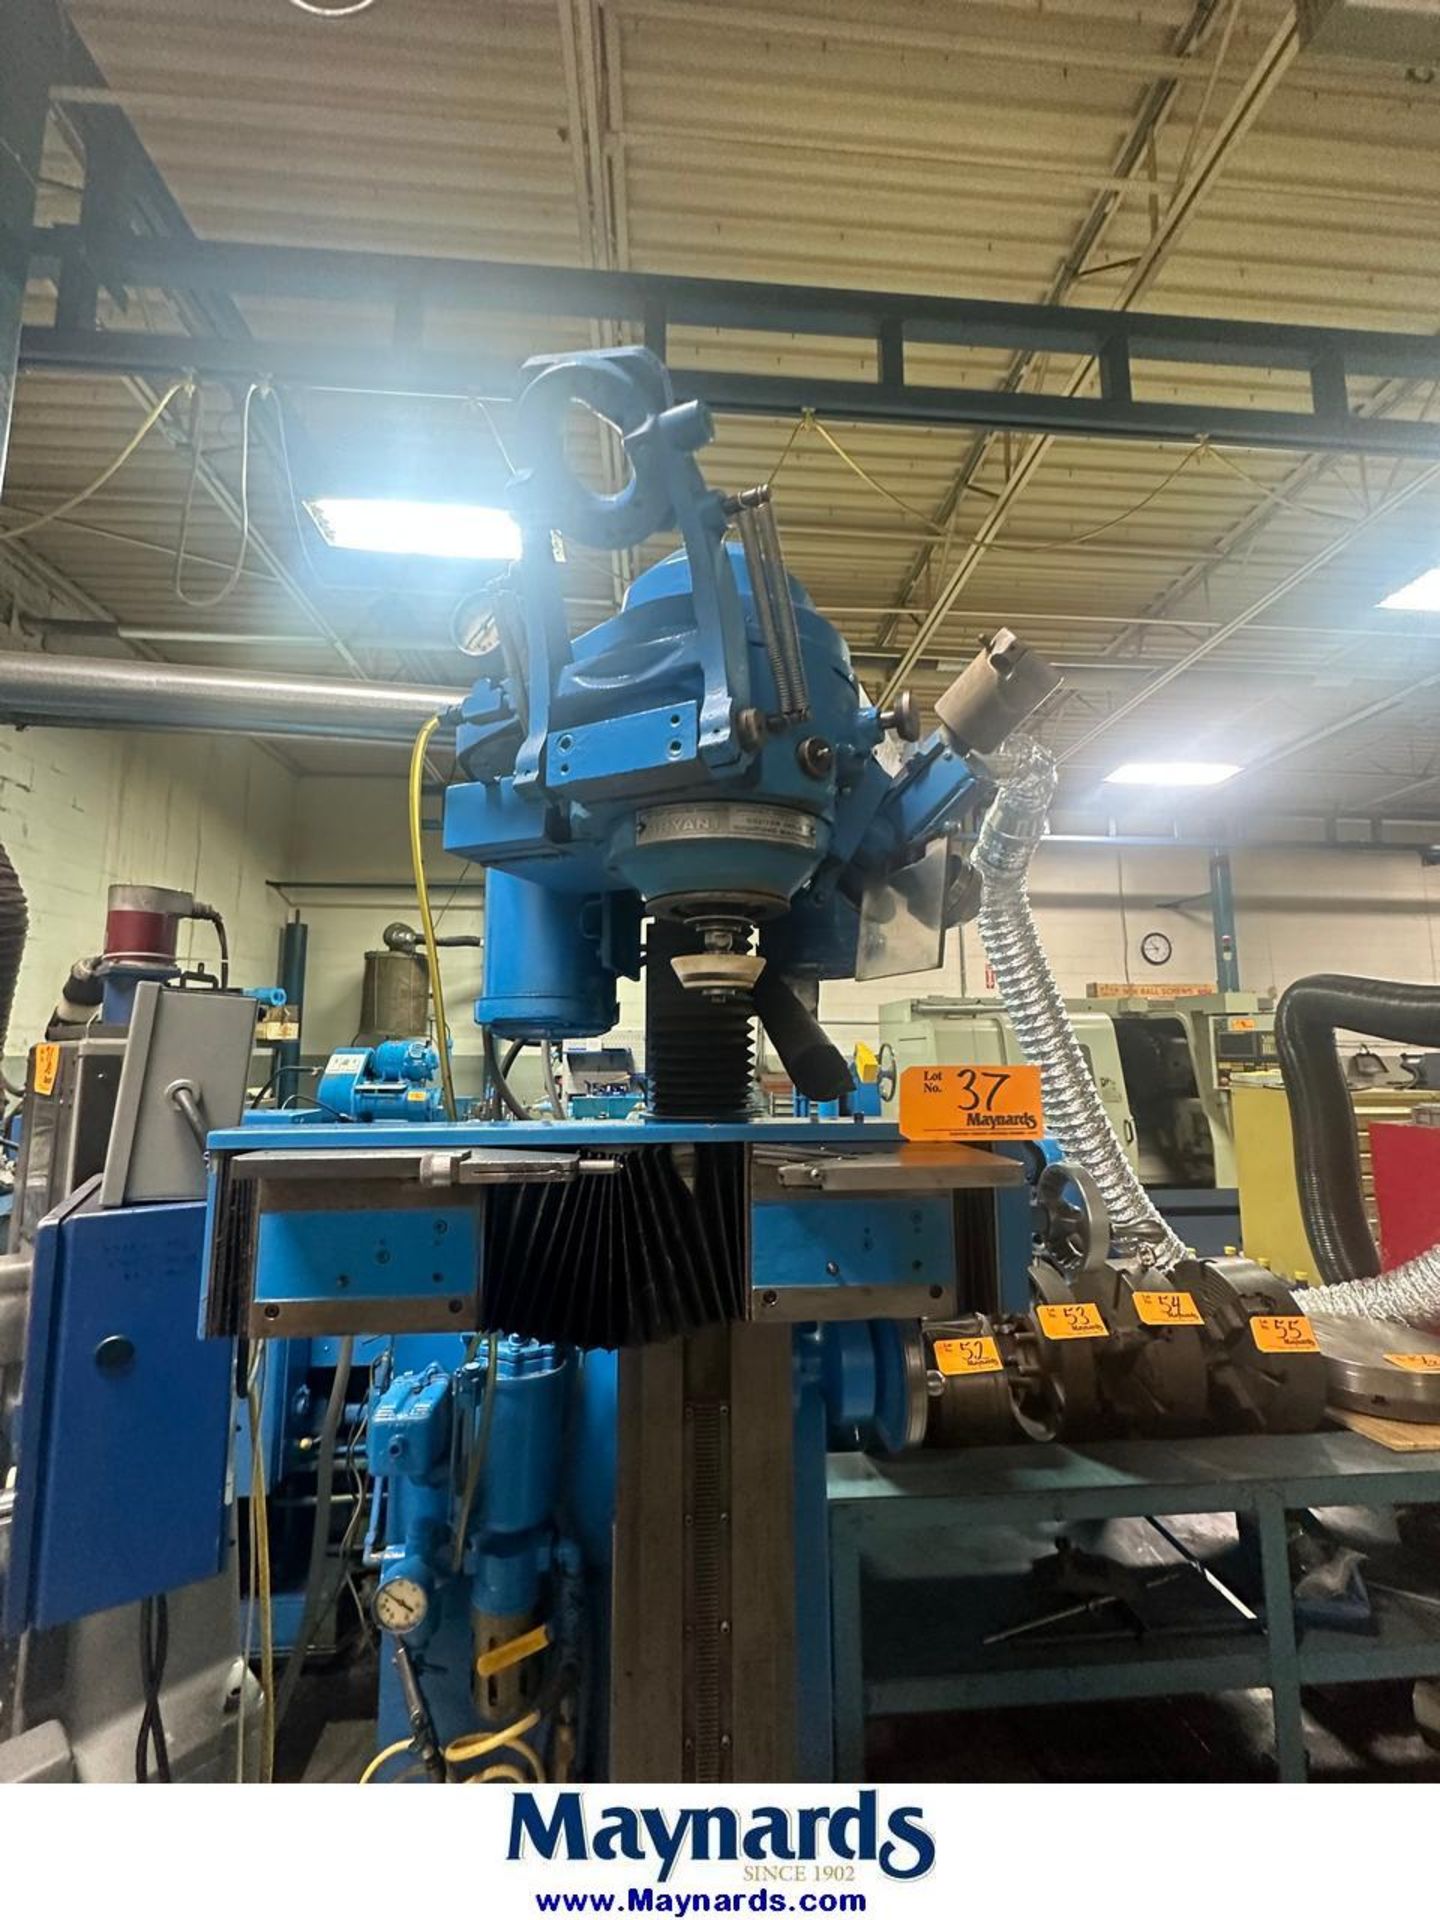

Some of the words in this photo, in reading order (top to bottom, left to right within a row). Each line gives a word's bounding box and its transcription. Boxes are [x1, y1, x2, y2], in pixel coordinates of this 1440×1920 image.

[923, 1071, 942, 1081] Lot
[923, 1082, 942, 1093] No.
[957, 1068, 1011, 1111] 37
[966, 1112, 1037, 1130] Maynards
[1158, 1295, 1180, 1316] 54
[1063, 1306, 1090, 1325] 53
[1274, 1319, 1302, 1339] 55
[959, 1340, 989, 1361] 52
